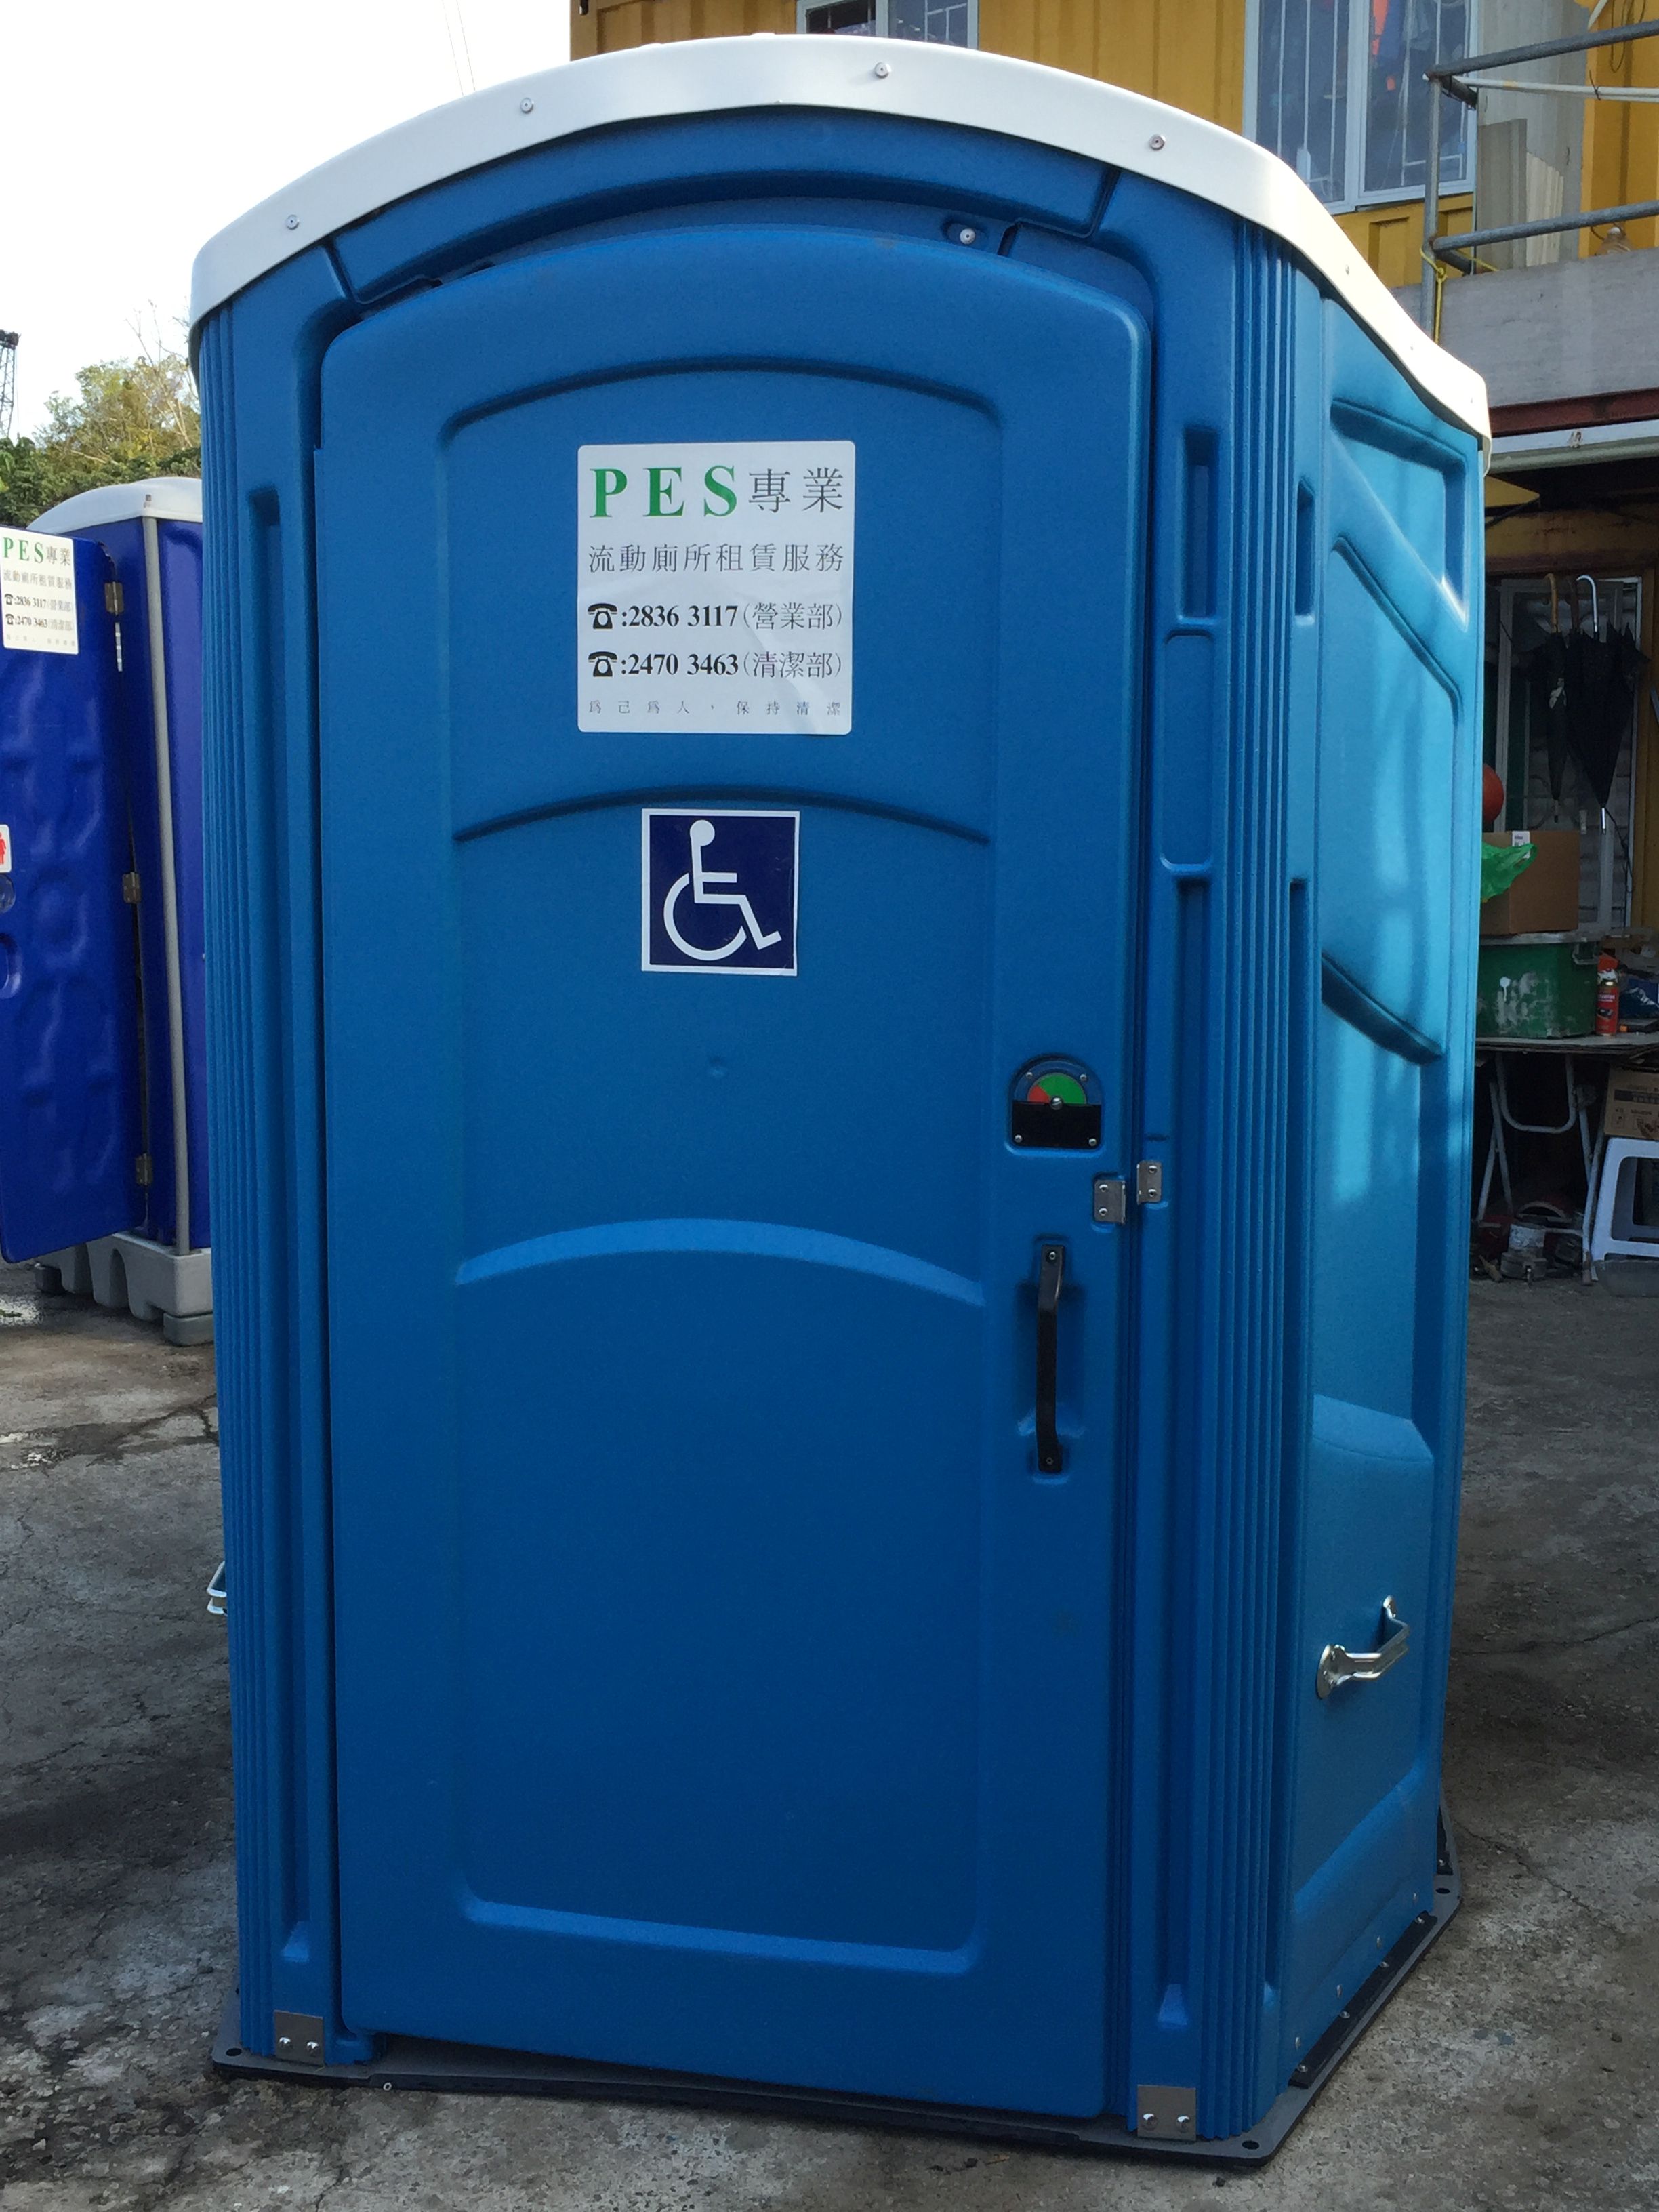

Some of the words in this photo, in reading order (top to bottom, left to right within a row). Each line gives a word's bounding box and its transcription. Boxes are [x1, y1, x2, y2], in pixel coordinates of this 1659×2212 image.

[589, 465, 737, 518] PES
[748, 467, 844, 514] 專業
[3, 537, 44, 564] PES
[588, 543, 844, 573] 流動廁所租賃服務
[687, 605, 738, 627] 3117
[687, 654, 739, 675] 3463
